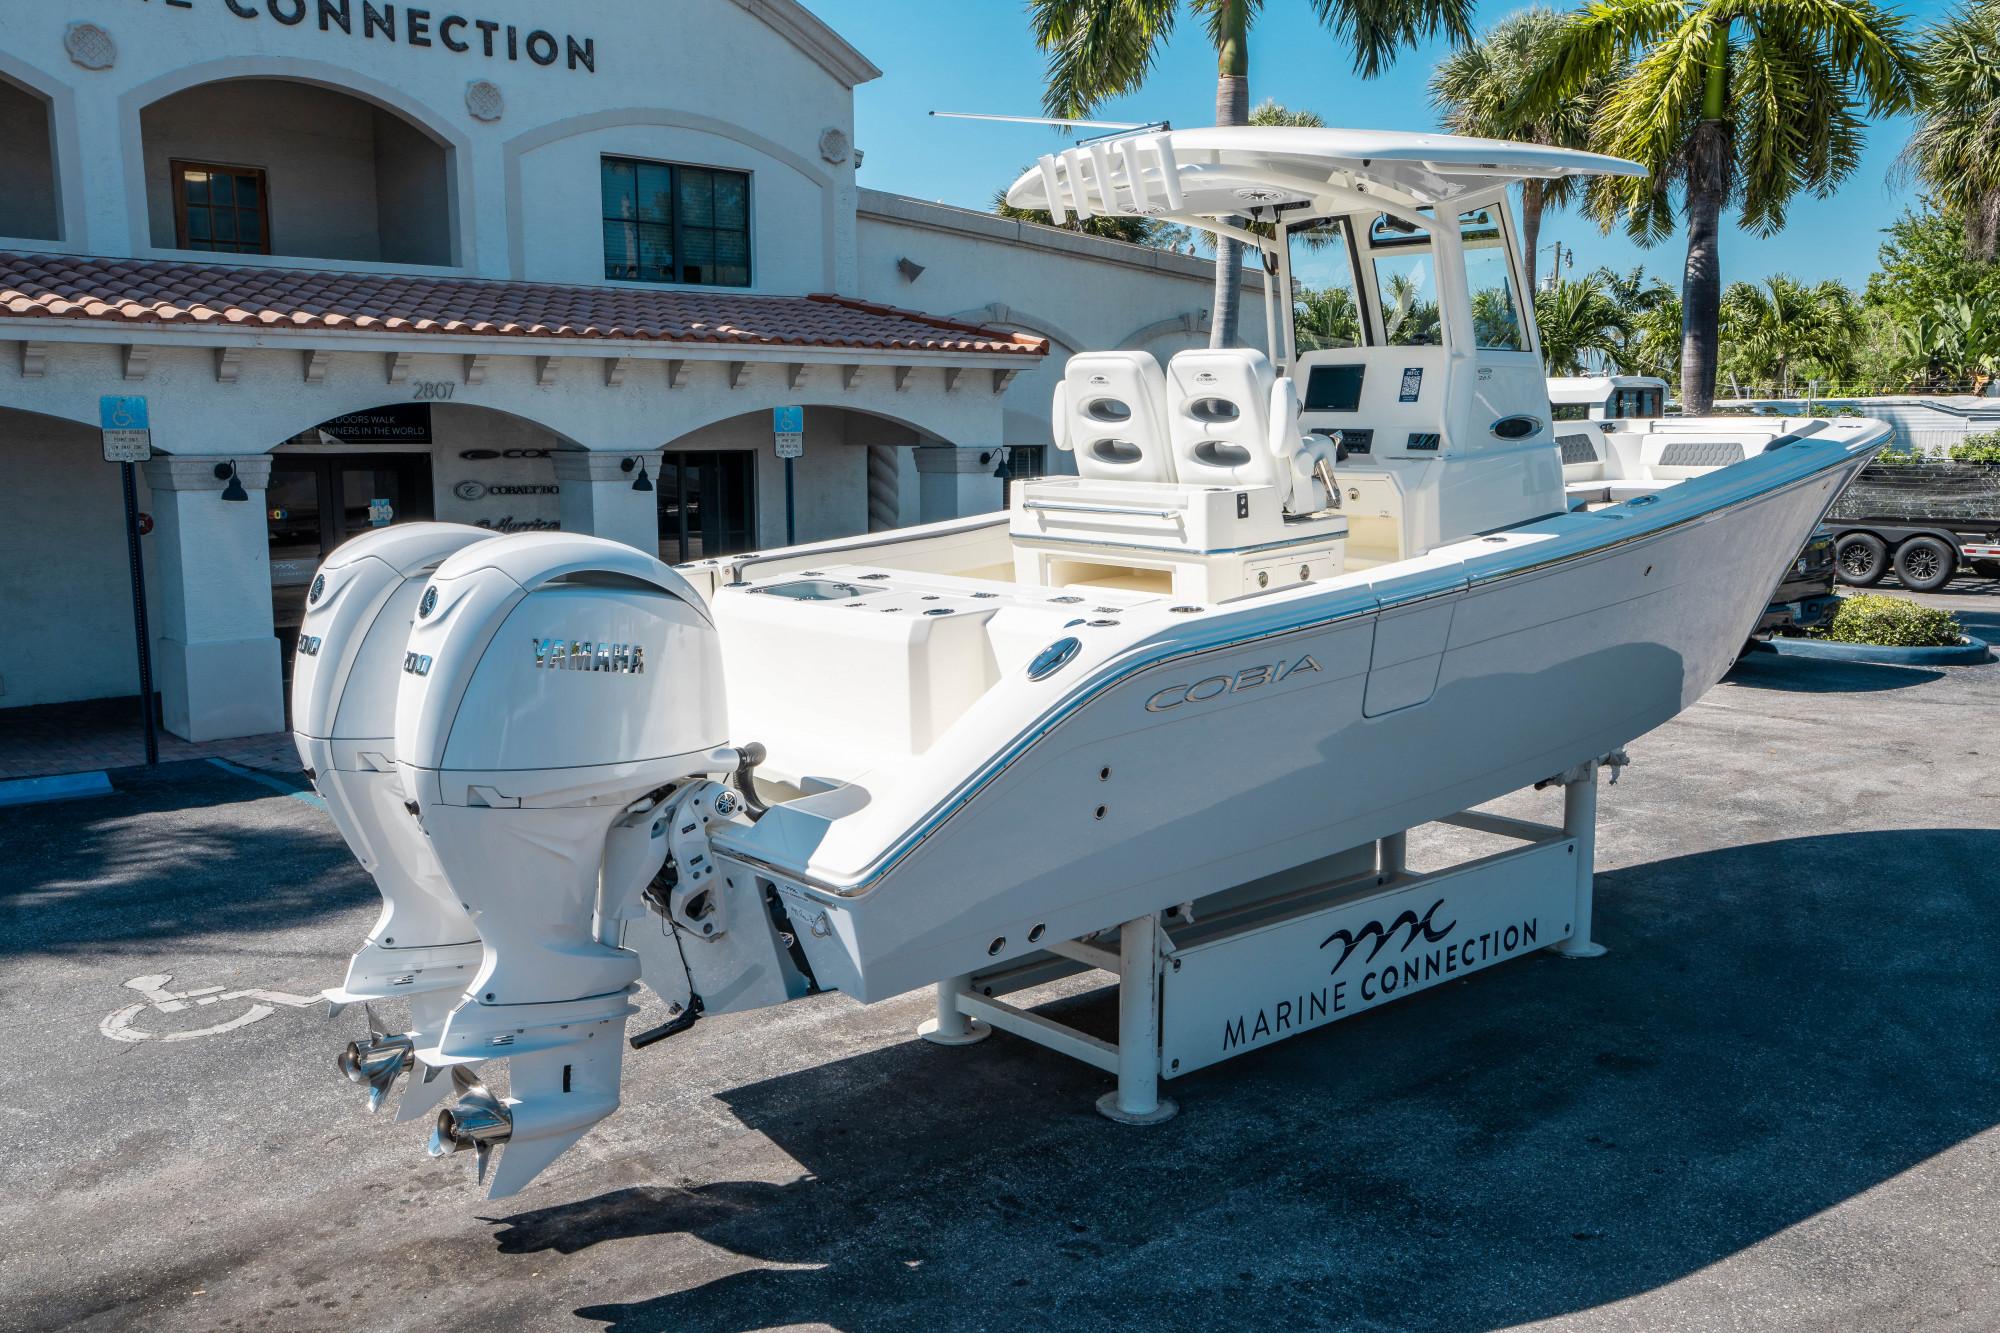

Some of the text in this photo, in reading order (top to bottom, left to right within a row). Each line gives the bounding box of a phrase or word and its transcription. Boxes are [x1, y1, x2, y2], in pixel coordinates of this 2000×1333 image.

[413, 381, 455, 400] 2807
[335, 415, 396, 424] DOORS WALK
[361, 426, 372, 435] IN
[373, 426, 391, 435] THE
[391, 426, 425, 435] WORLD
[489, 485, 538, 495] COBALT
[297, 632, 322, 657] 00
[532, 638, 645, 674] YAMAHA
[403, 650, 433, 678] 00
[1145, 654, 1324, 713] COBIA
[1222, 917, 1538, 1051] MARINE CONNECTION
